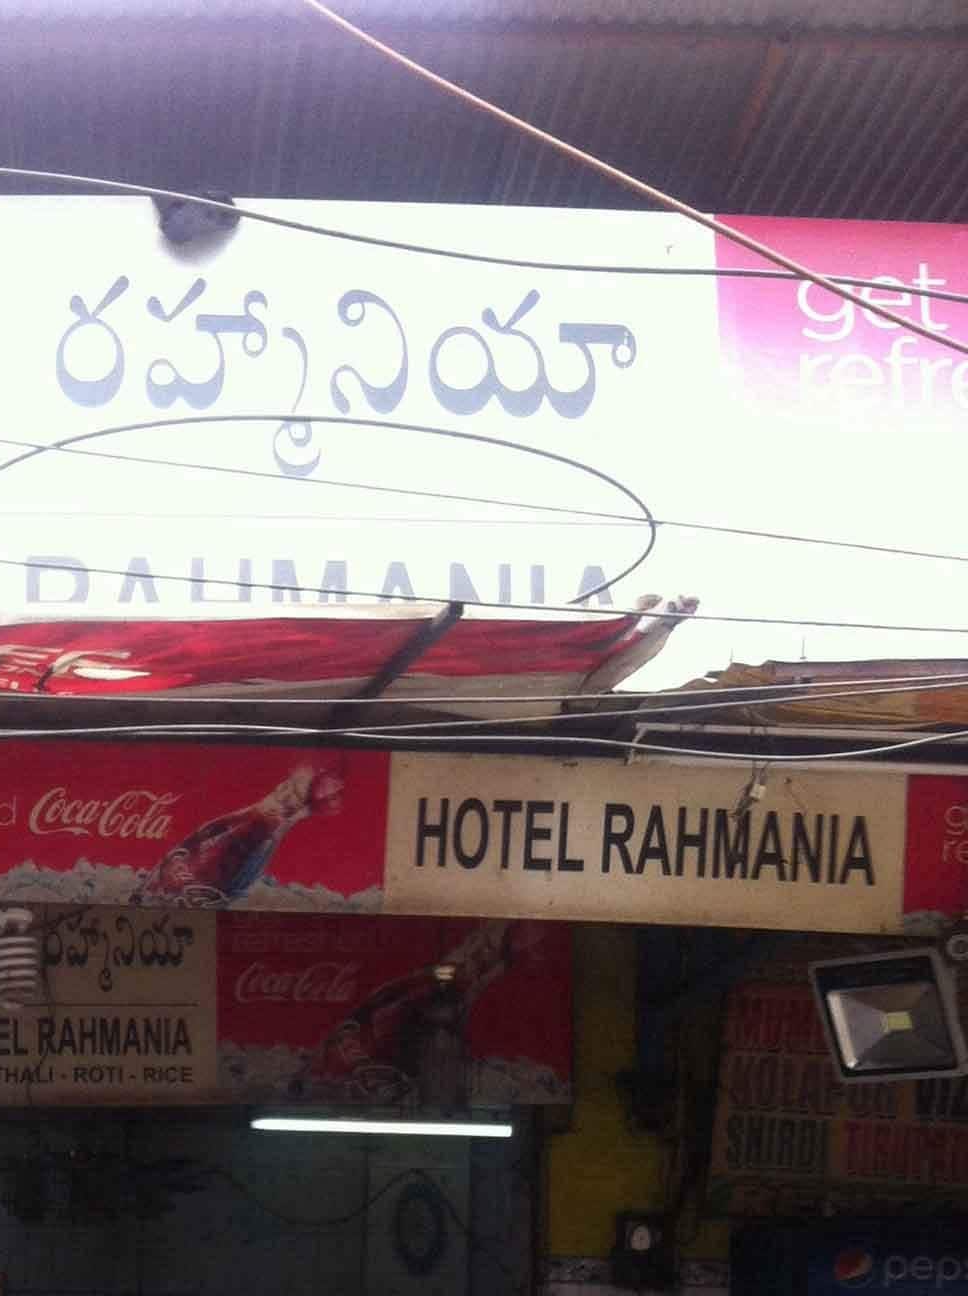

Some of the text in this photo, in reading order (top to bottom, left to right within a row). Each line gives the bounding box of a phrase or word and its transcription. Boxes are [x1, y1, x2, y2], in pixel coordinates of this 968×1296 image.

[797, 263, 949, 342] get
[28, 787, 183, 840] Coca-Cola
[415, 797, 877, 887] HOTEL RAHMANIA
[235, 961, 363, 1003] Coca-Cola
[37, 1016, 193, 1057] RAHMANIA
[73, 1065, 124, 1085] ROTI
[143, 1065, 193, 1085] RICE
